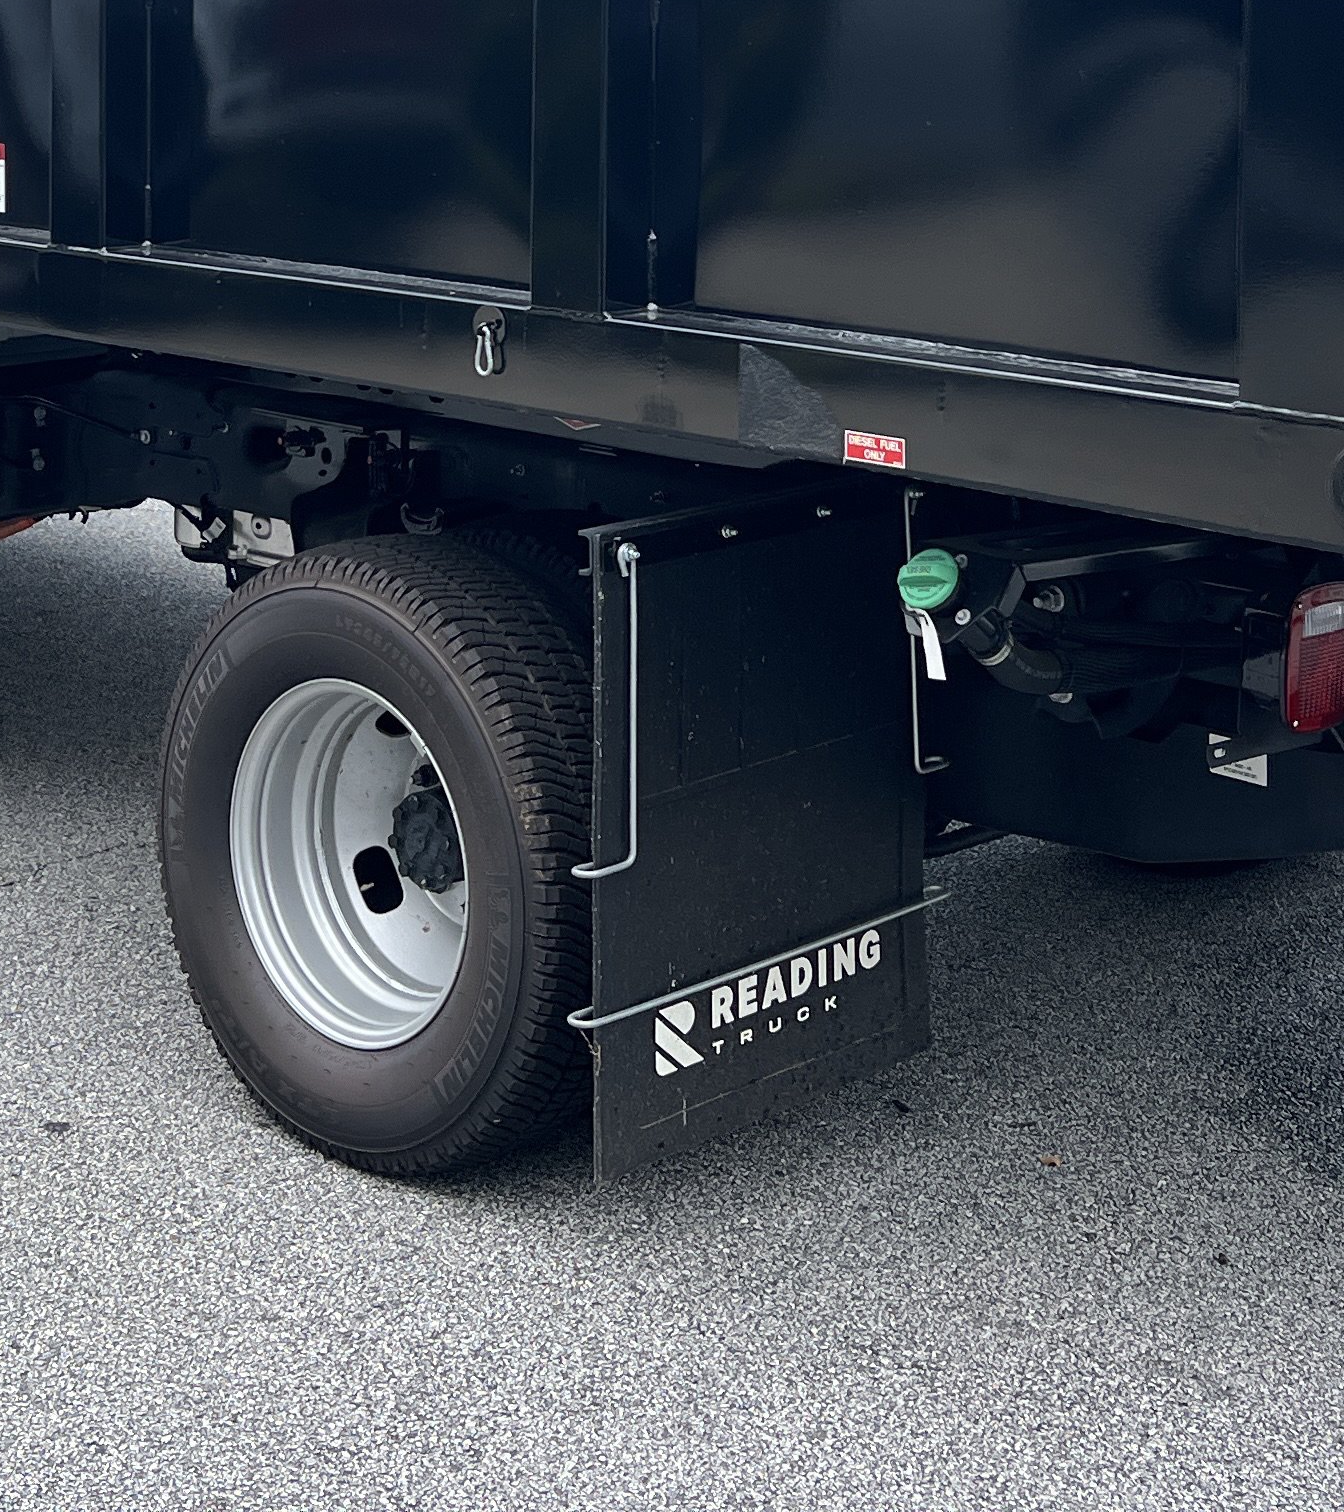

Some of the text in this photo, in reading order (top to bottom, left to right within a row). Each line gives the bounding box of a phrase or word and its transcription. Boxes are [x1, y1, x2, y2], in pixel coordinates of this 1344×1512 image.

[849, 435, 901, 452] DIESEL FUEL
[863, 449, 886, 461] ONLY
[168, 647, 229, 805] MICHELIN
[711, 929, 881, 1029] READING
[434, 933, 513, 1105] MICHELIN
[712, 996, 837, 1055] TRUCK
